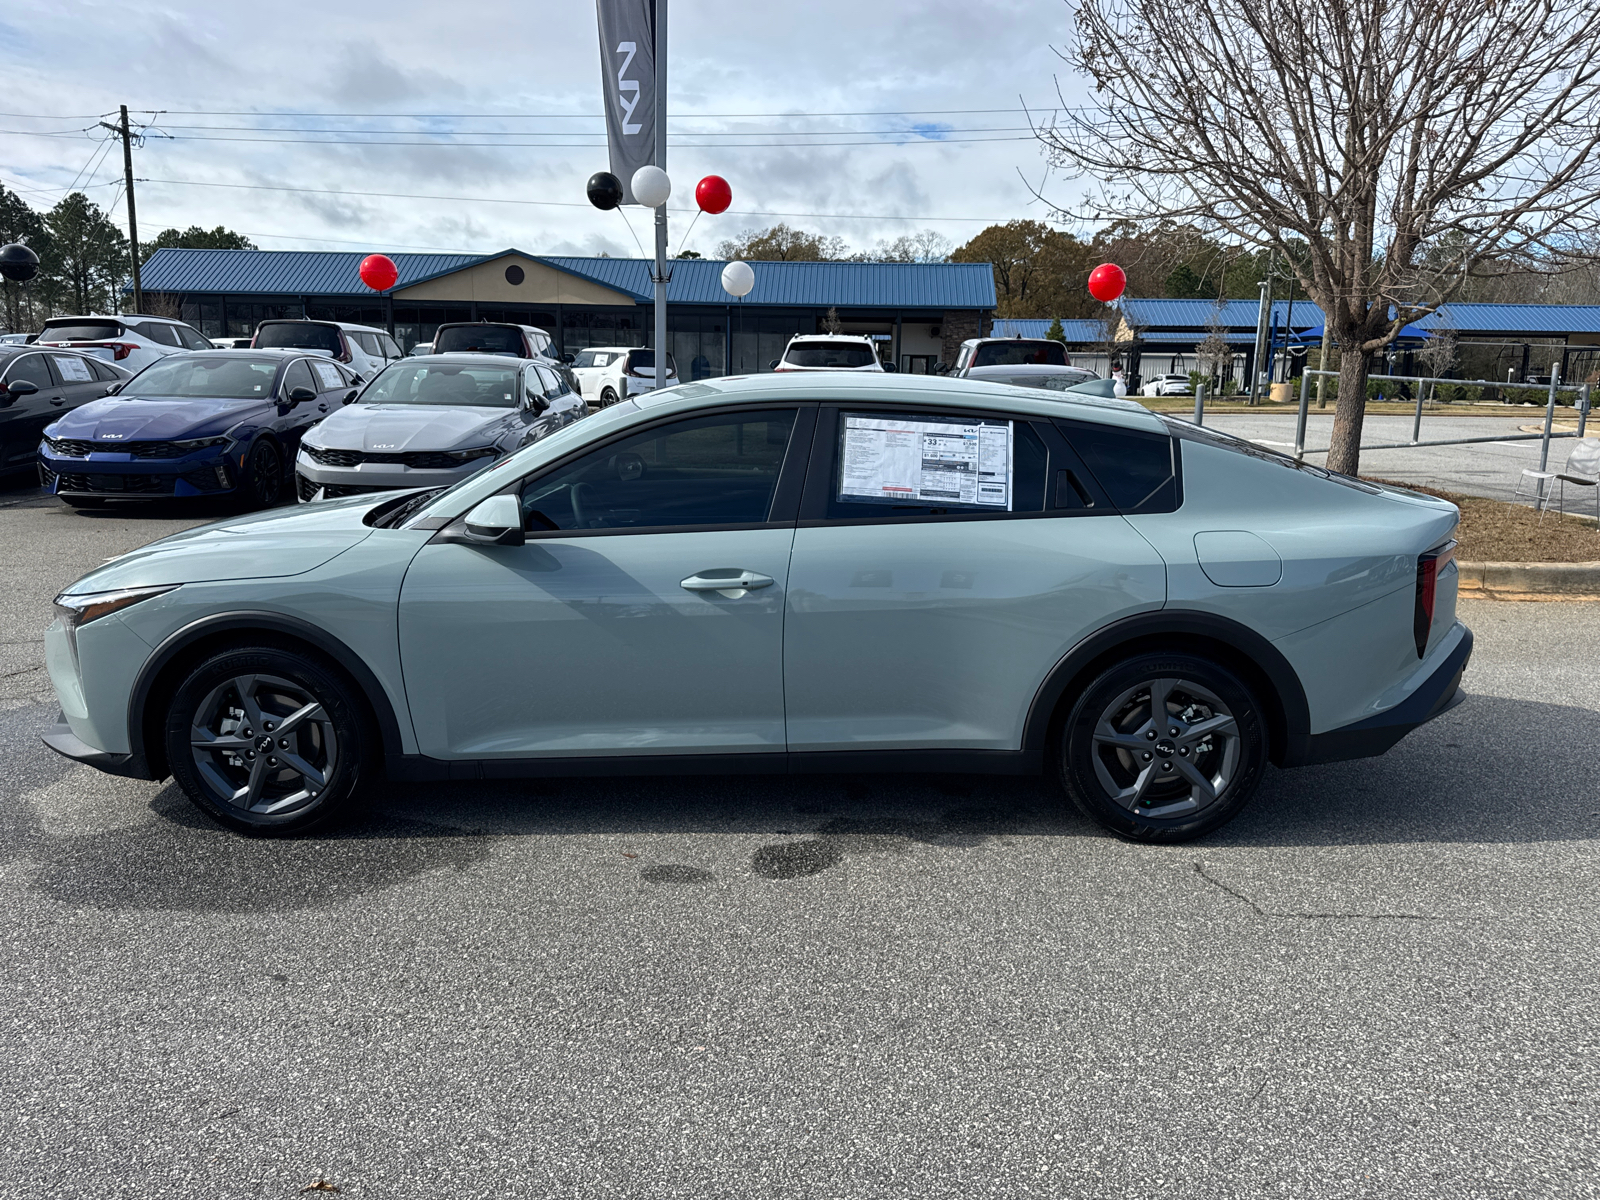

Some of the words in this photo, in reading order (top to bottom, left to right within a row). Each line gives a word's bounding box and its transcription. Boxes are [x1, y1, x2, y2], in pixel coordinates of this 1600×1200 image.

[616, 41, 642, 134] KIA
[1136, 661, 1197, 674] KUMHO
[1156, 744, 1175, 754] KIA
